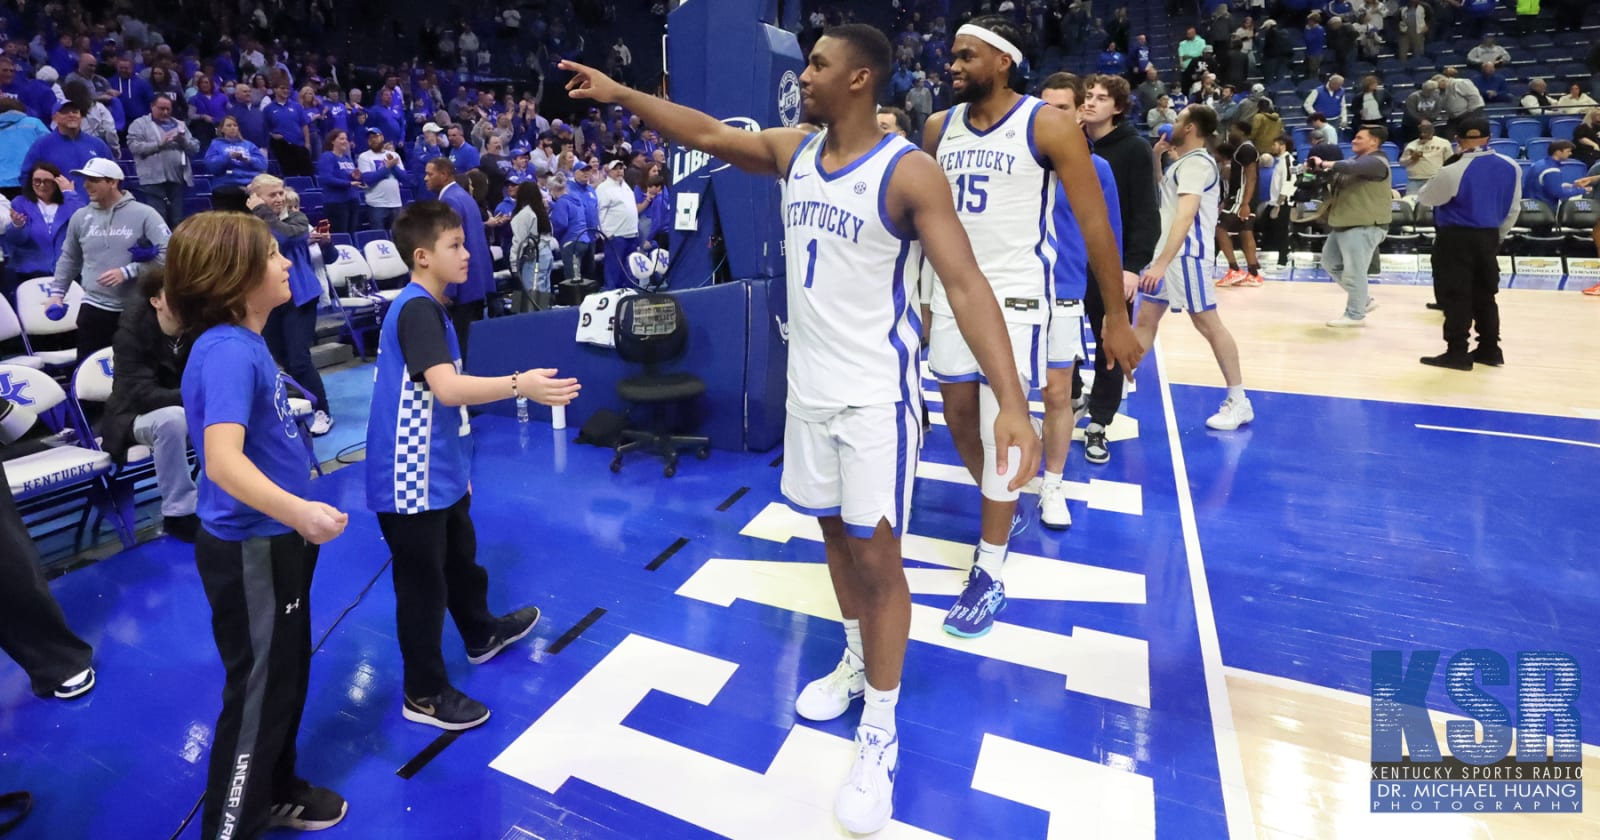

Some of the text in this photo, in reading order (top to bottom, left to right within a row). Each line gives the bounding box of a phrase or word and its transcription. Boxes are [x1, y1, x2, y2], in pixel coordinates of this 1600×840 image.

[940, 149, 1016, 175] KENTUCKY
[956, 174, 989, 213] 15
[787, 201, 865, 244] KENTUCKY
[634, 256, 649, 272] UK
[804, 239, 817, 288] 1
[23, 461, 95, 491] KENTUCKY
[227, 753, 251, 808] UNDER
